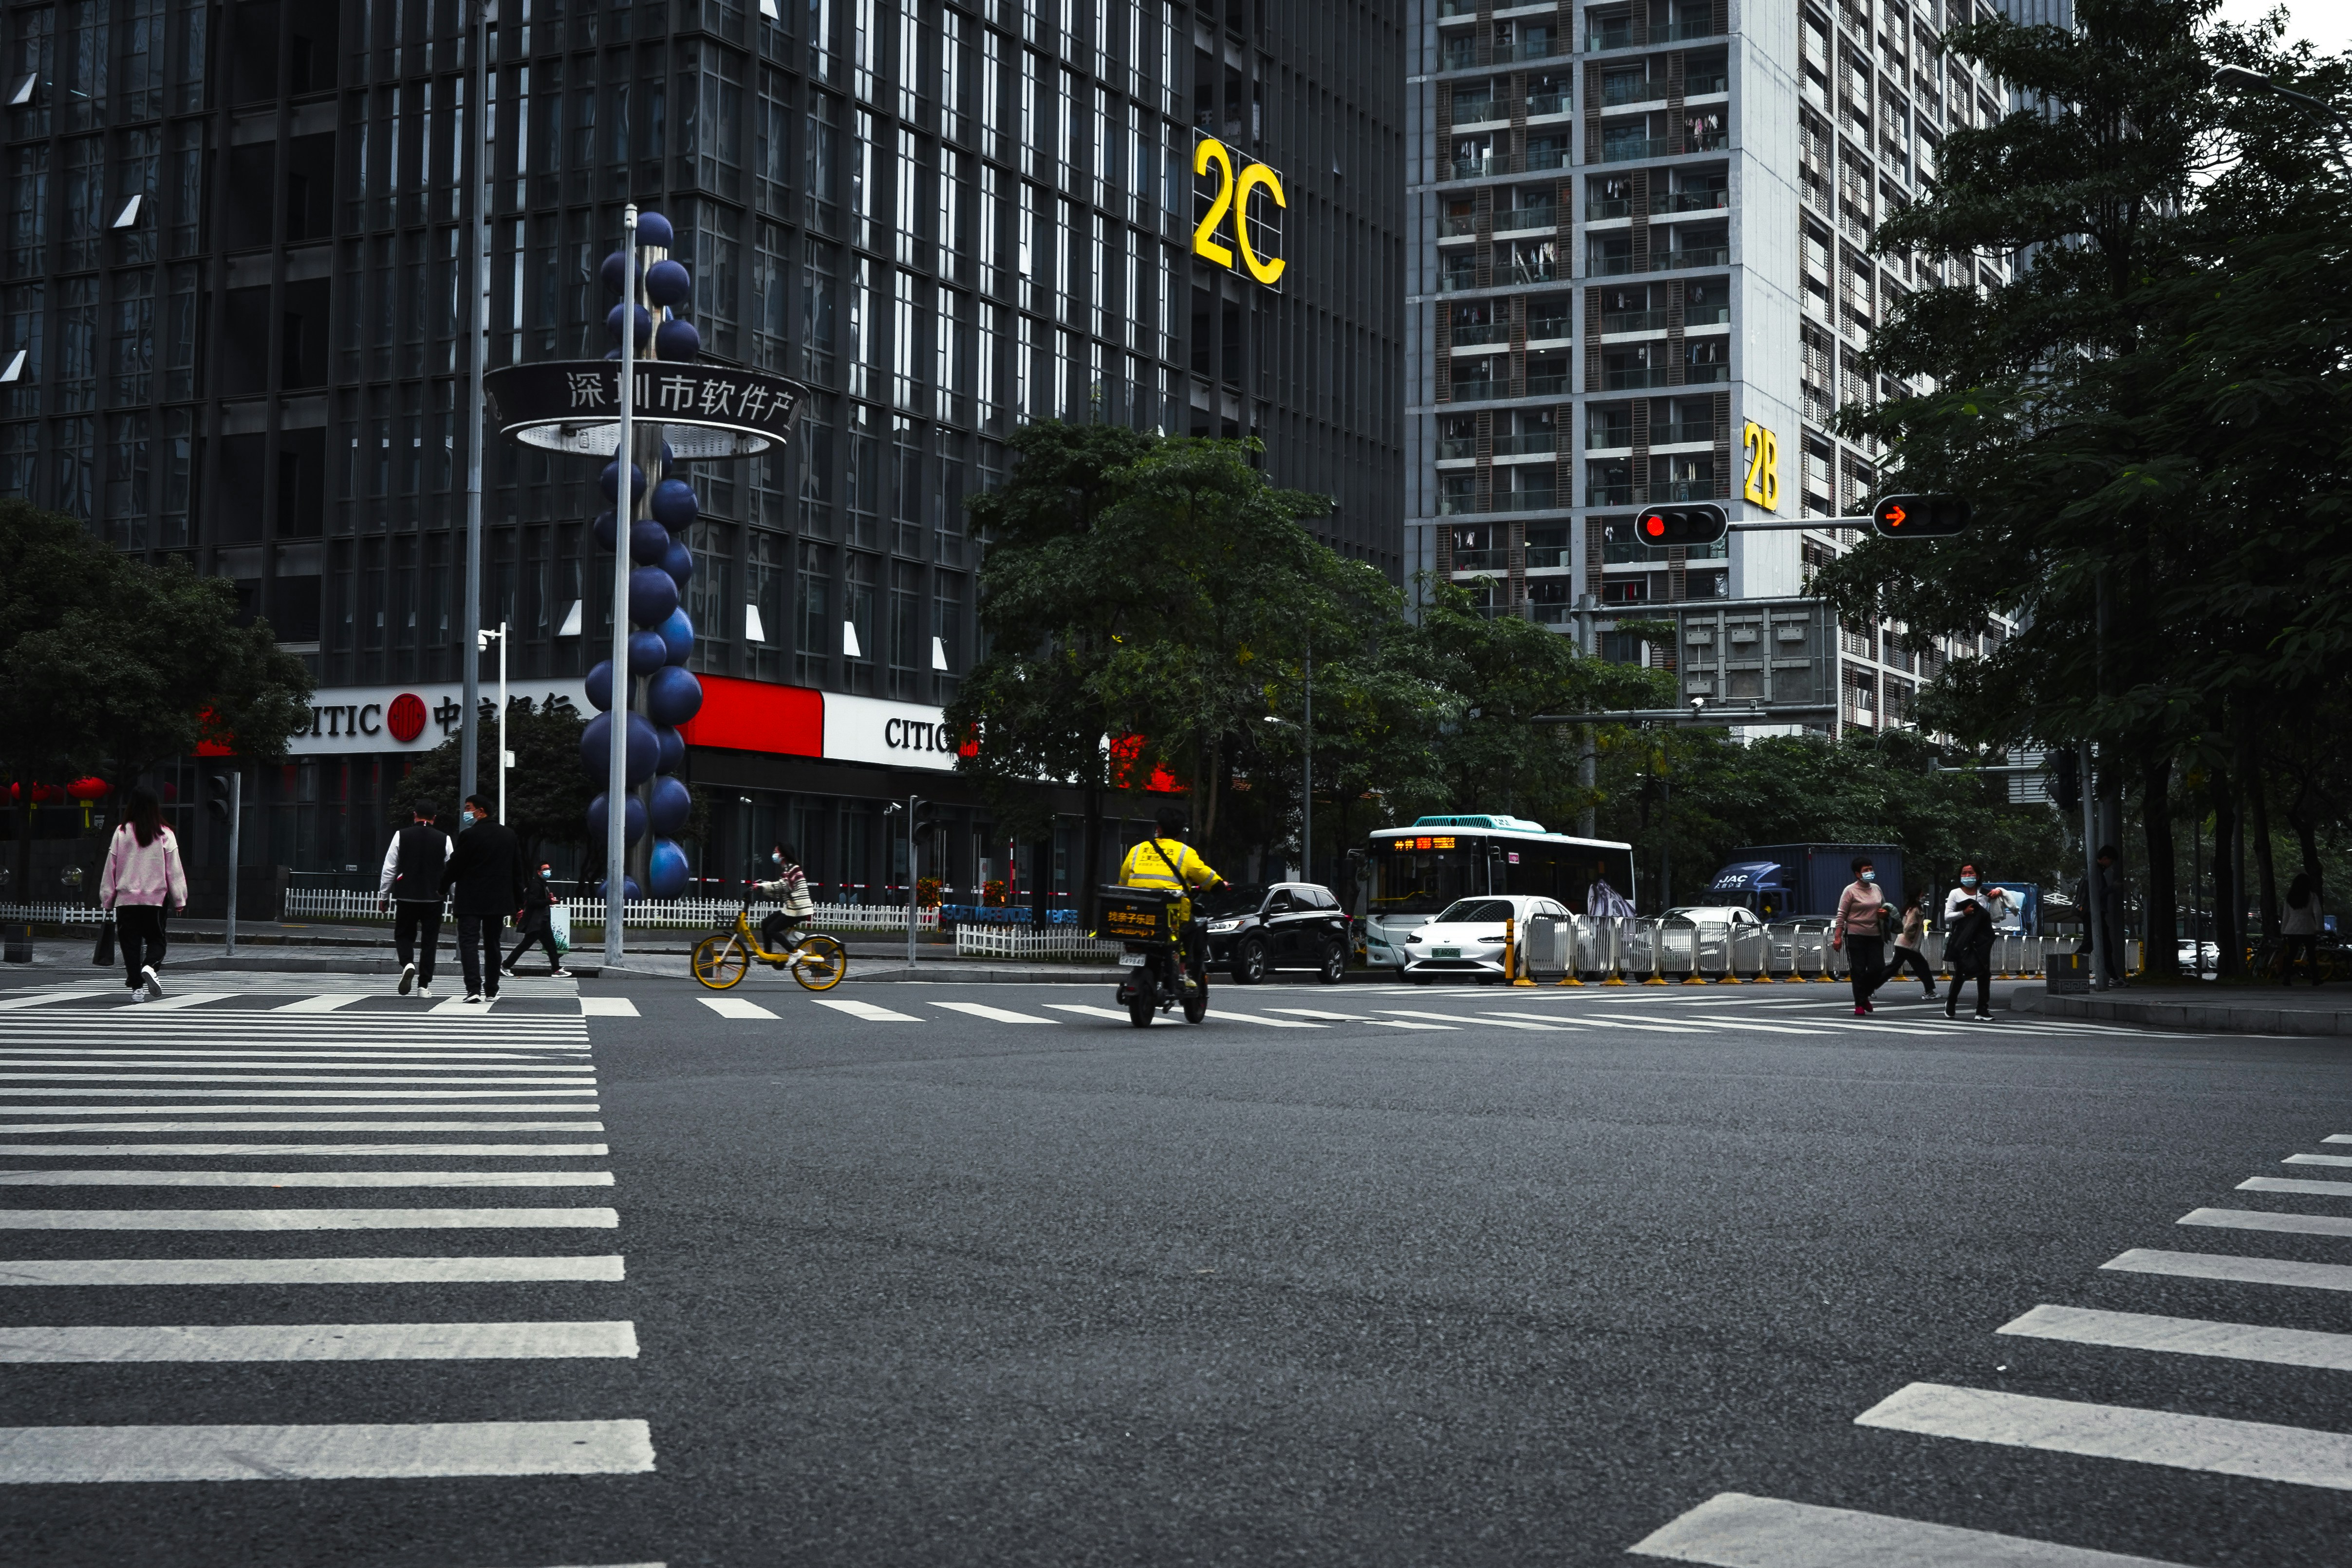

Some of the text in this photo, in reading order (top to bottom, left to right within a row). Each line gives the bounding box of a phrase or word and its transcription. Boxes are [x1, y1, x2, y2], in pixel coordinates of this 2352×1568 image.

[1193, 138, 1287, 284] 2C
[566, 372, 803, 430] 深圳市软件产
[1744, 422, 1778, 511] 2B
[293, 704, 381, 736] ITIC
[1719, 875, 1748, 883] JAC
